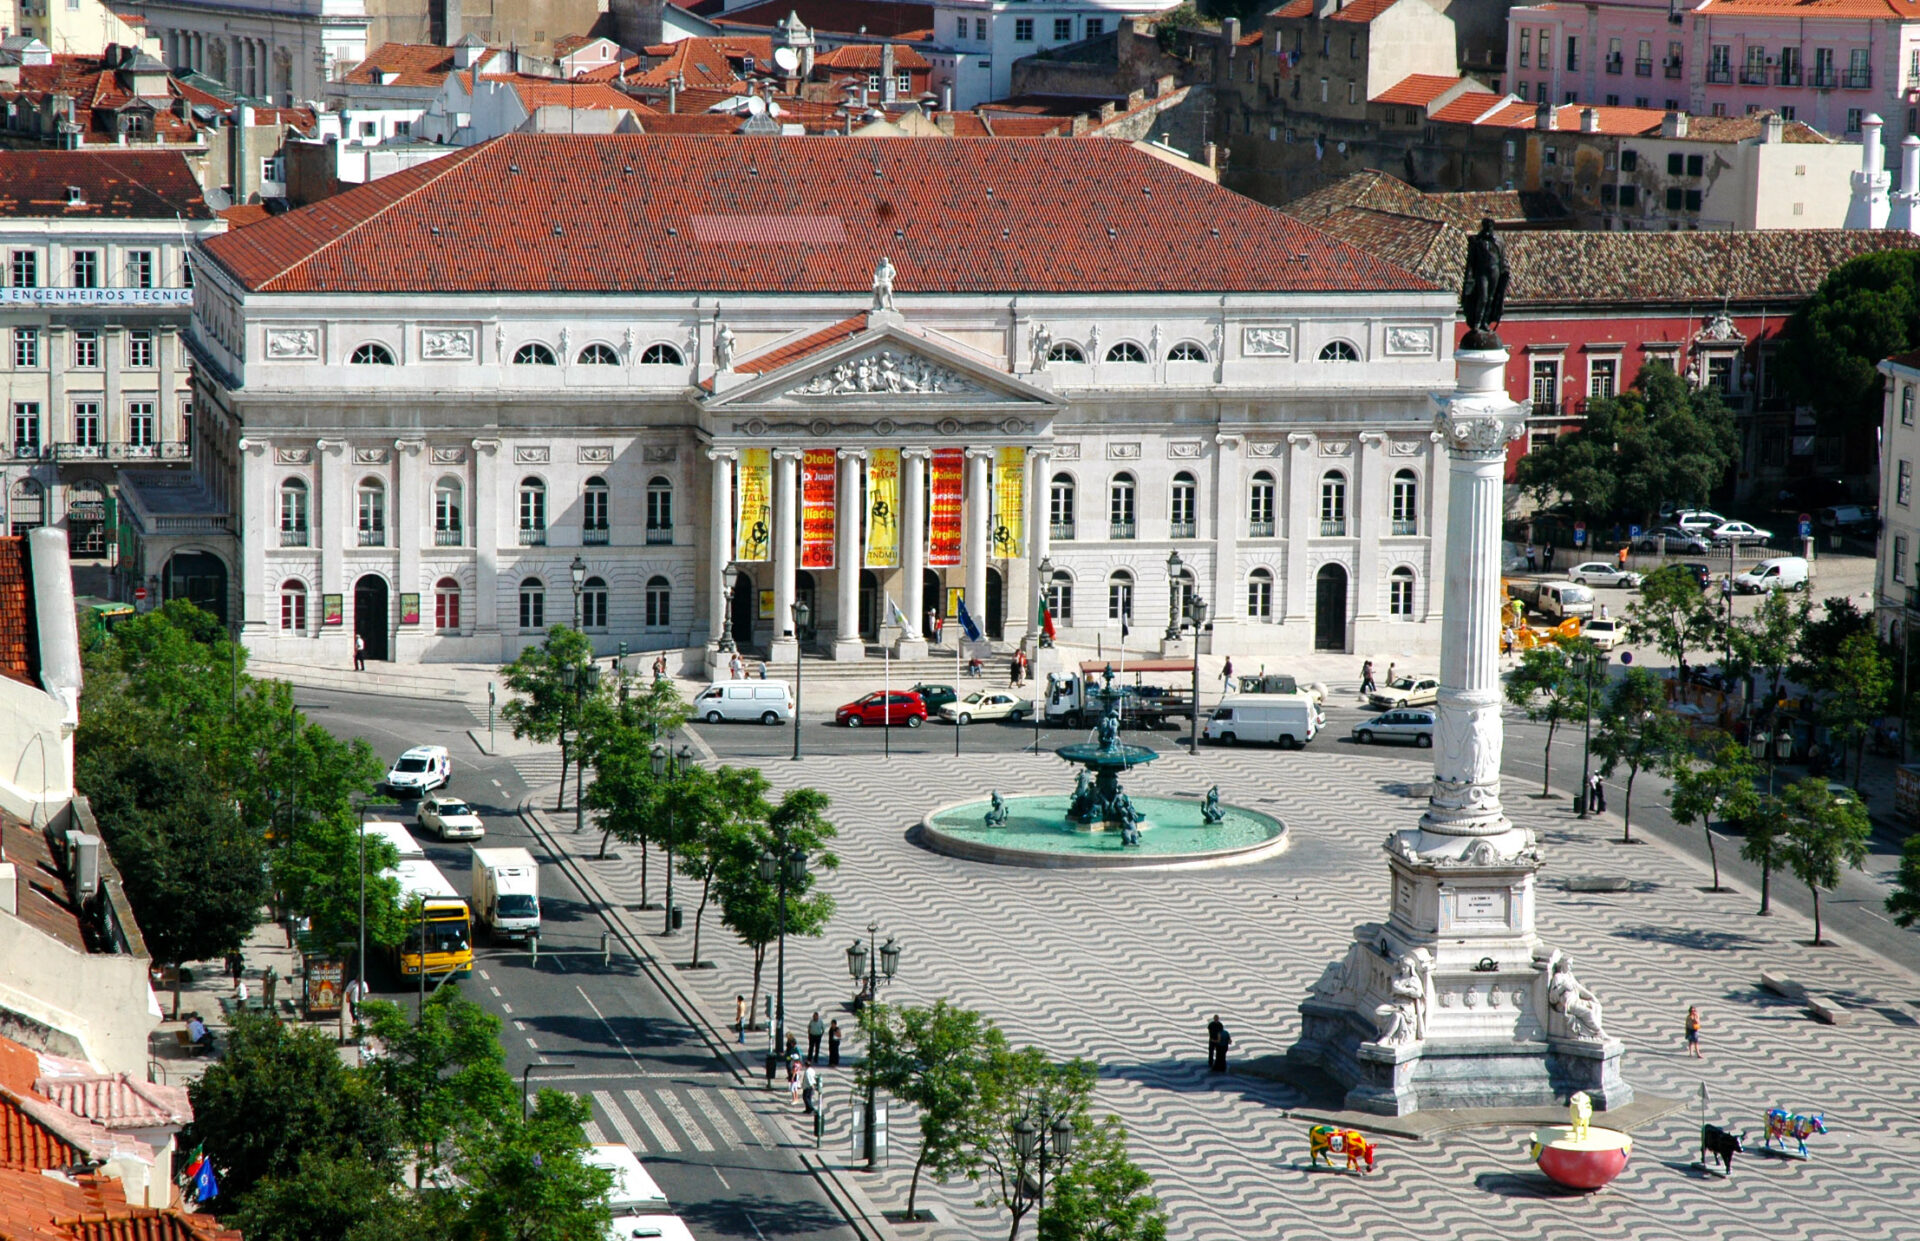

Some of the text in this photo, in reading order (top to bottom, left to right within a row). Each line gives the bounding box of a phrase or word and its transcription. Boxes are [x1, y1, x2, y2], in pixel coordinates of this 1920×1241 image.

[12, 289, 125, 300] ENGENHEIROS
[134, 288, 194, 300] TÉCNIC
[803, 454, 834, 465] Otelo
[814, 472, 834, 482] Juan
[1631, 526, 1639, 535] P
